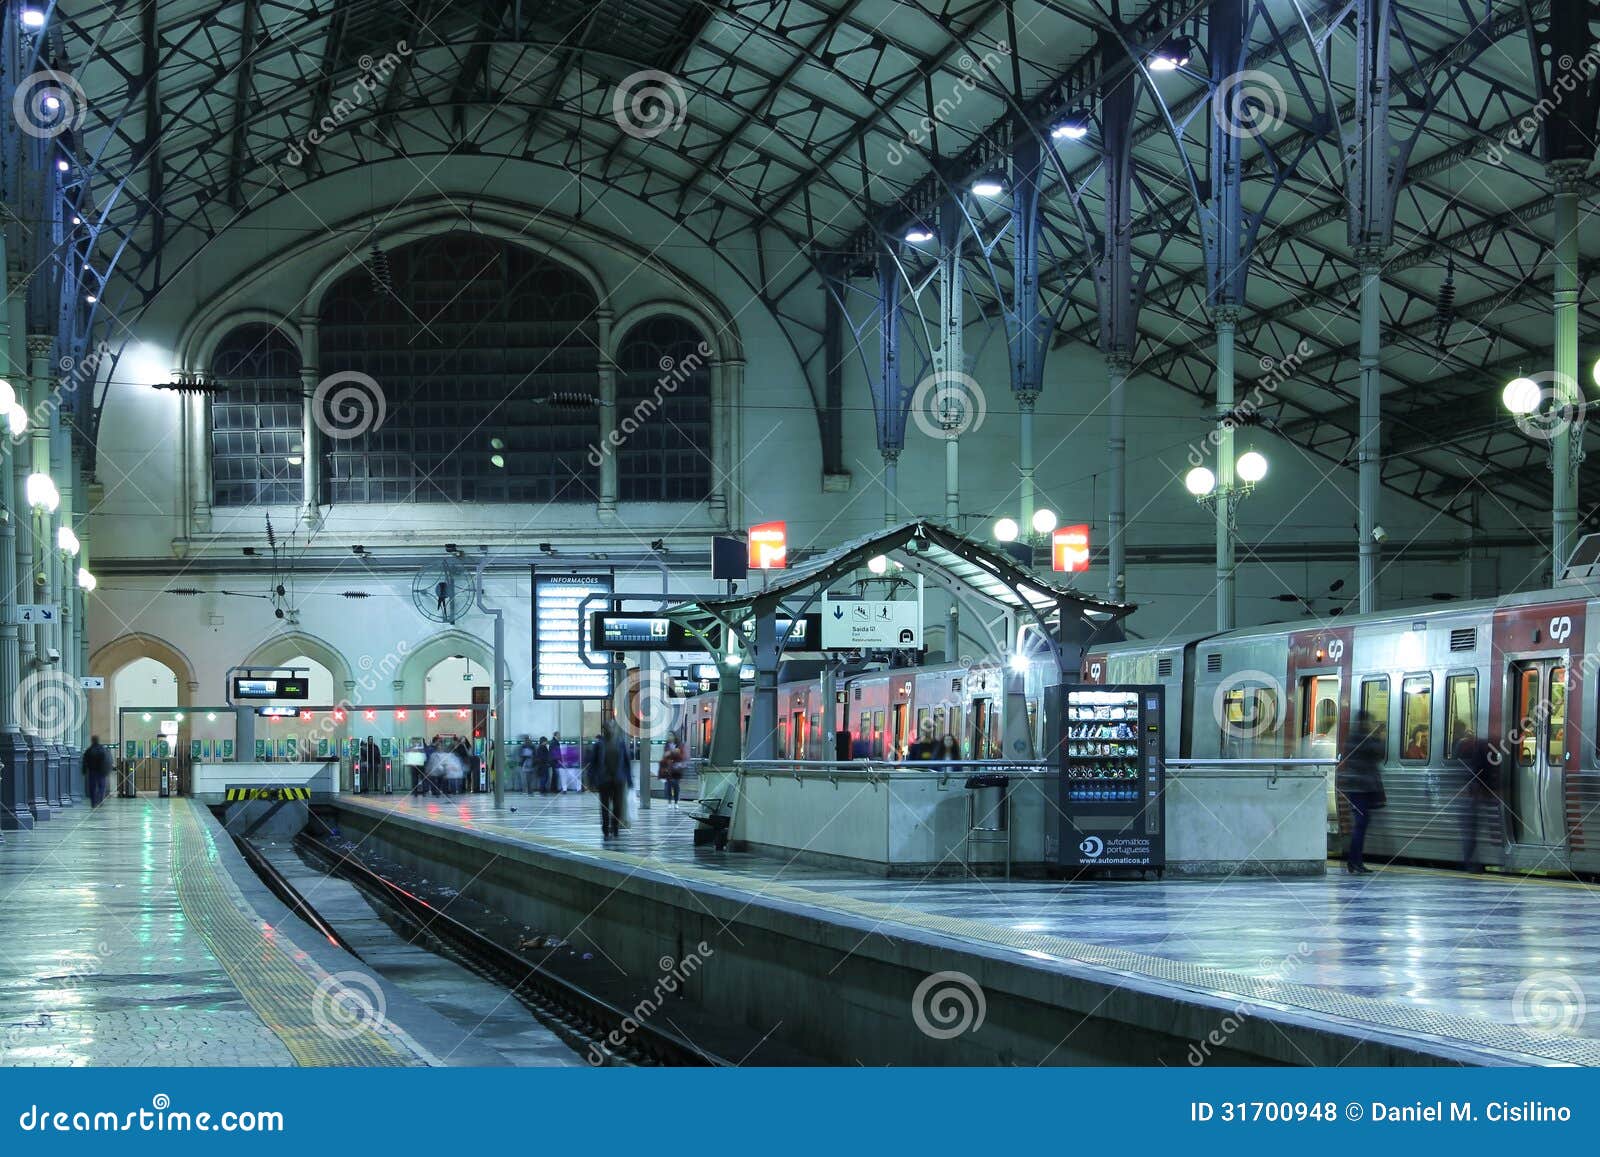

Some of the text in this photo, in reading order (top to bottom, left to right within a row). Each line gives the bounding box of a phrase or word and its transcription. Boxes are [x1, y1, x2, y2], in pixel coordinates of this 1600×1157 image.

[23, 612, 31, 620] 4
[1106, 847, 1150, 855] portugueses
[1079, 857, 1150, 865] www.automaticos.pt
